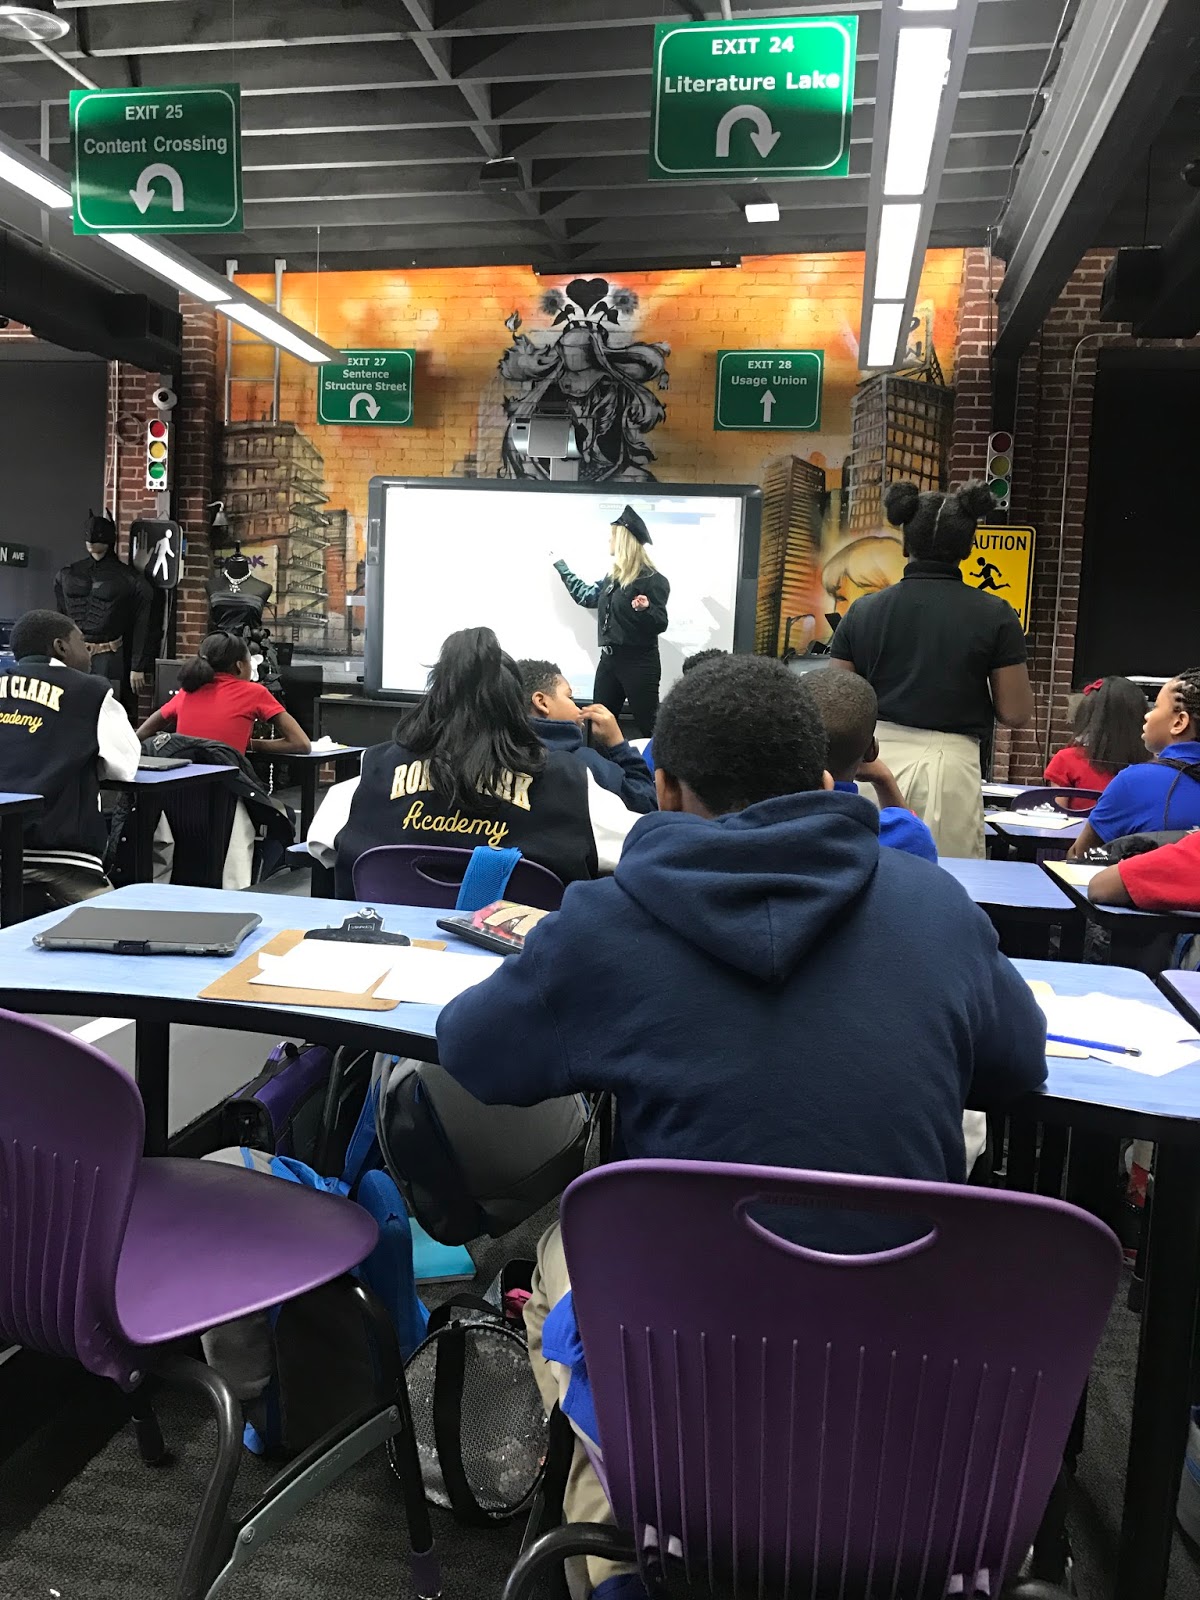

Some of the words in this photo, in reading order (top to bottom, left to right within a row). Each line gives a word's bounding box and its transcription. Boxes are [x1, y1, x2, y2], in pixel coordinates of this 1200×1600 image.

[711, 37, 760, 55] EXIT
[768, 36, 795, 53] 24
[664, 74, 776, 93] Literature
[786, 70, 840, 89] Lake
[125, 105, 159, 120] EXIT
[165, 104, 183, 119] 25
[83, 137, 147, 154] Content
[153, 135, 228, 155] Crossing
[347, 357, 370, 366] EXIT
[374, 357, 386, 366] 27
[747, 360, 774, 369] EXIT
[778, 360, 792, 369] 28
[342, 369, 389, 378] Sentence
[731, 375, 768, 387] Usage
[772, 375, 808, 385] Union
[325, 381, 372, 390] Structure
[375, 381, 407, 391] Street
[973, 535, 1027, 550] AUTION
[12, 551, 25, 561] AVE
[11, 675, 65, 712] CLARK
[402, 800, 509, 846] Academy
